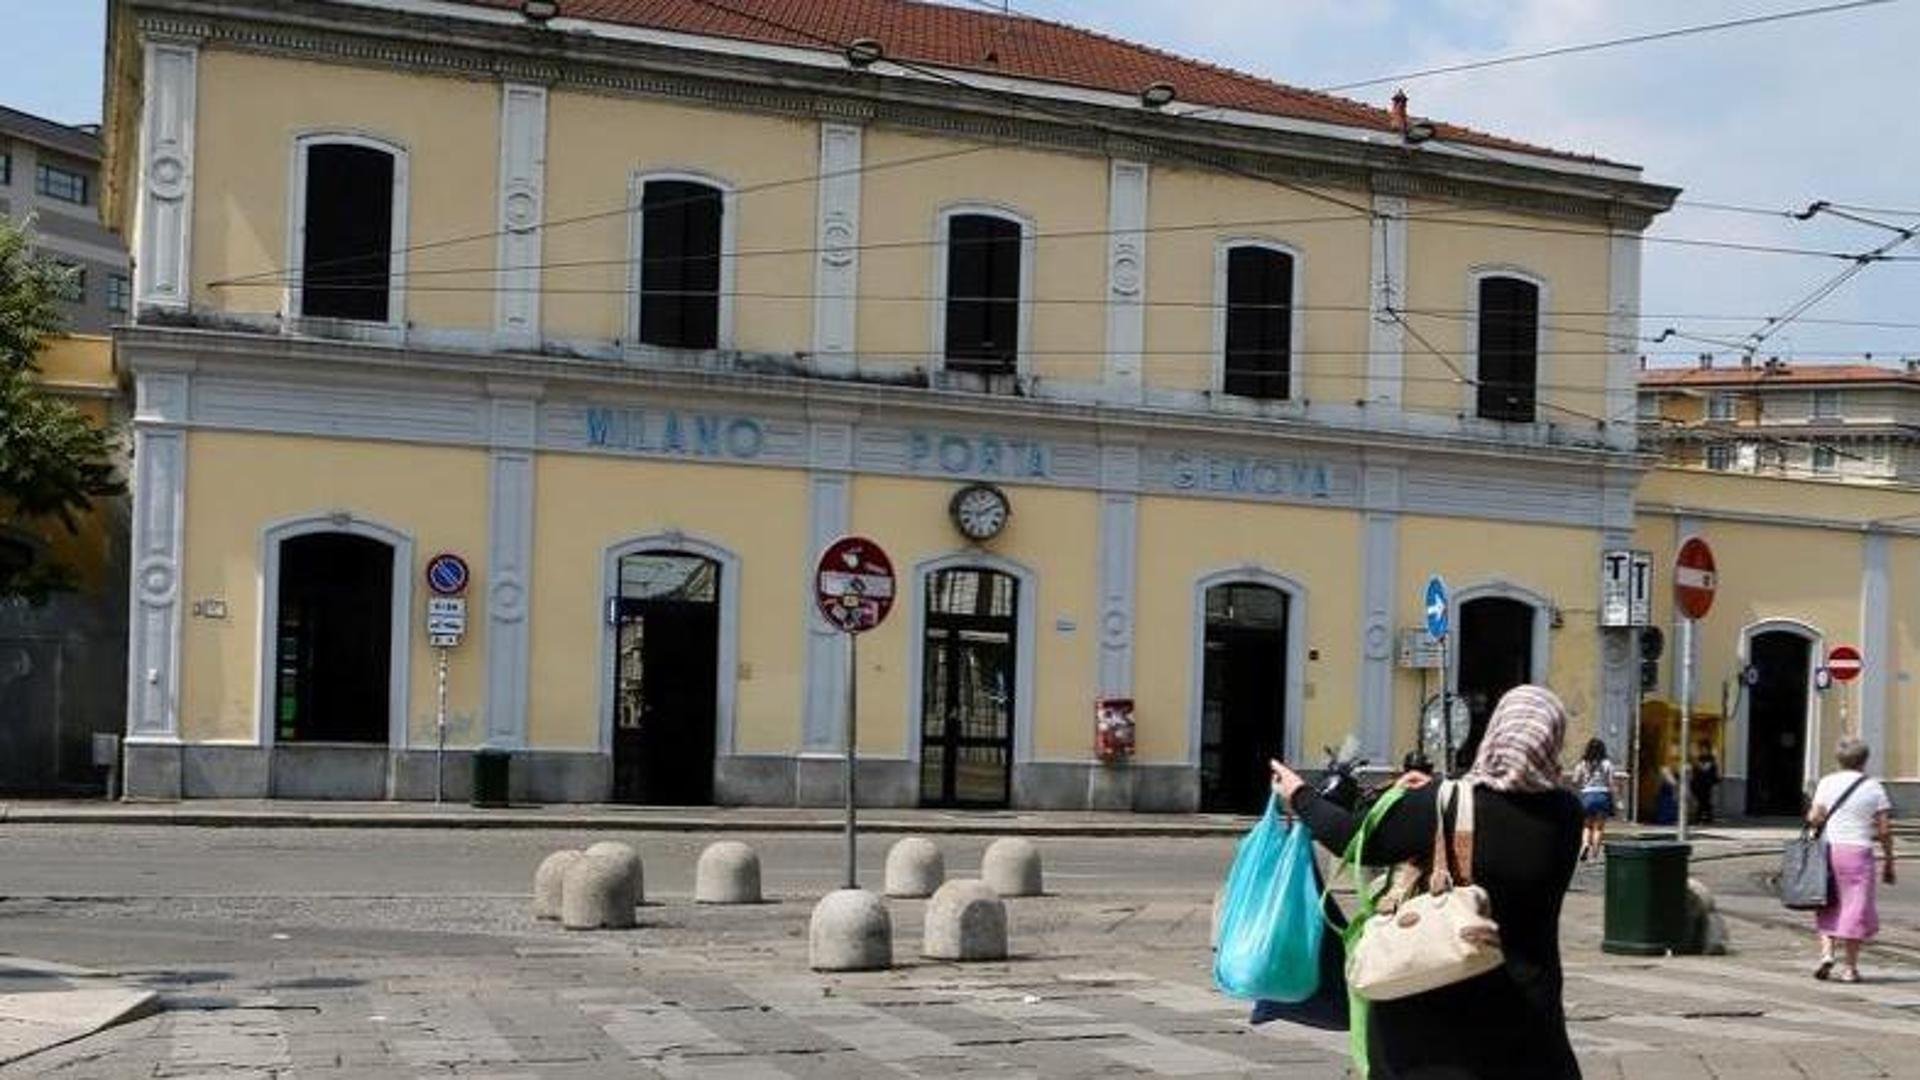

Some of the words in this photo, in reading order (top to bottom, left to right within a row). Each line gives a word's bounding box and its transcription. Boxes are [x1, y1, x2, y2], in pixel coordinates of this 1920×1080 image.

[586, 407, 764, 458] MILANO
[909, 431, 1052, 478] PORTA
[1173, 452, 1330, 498] GENOVA
[1606, 556, 1628, 580] T
